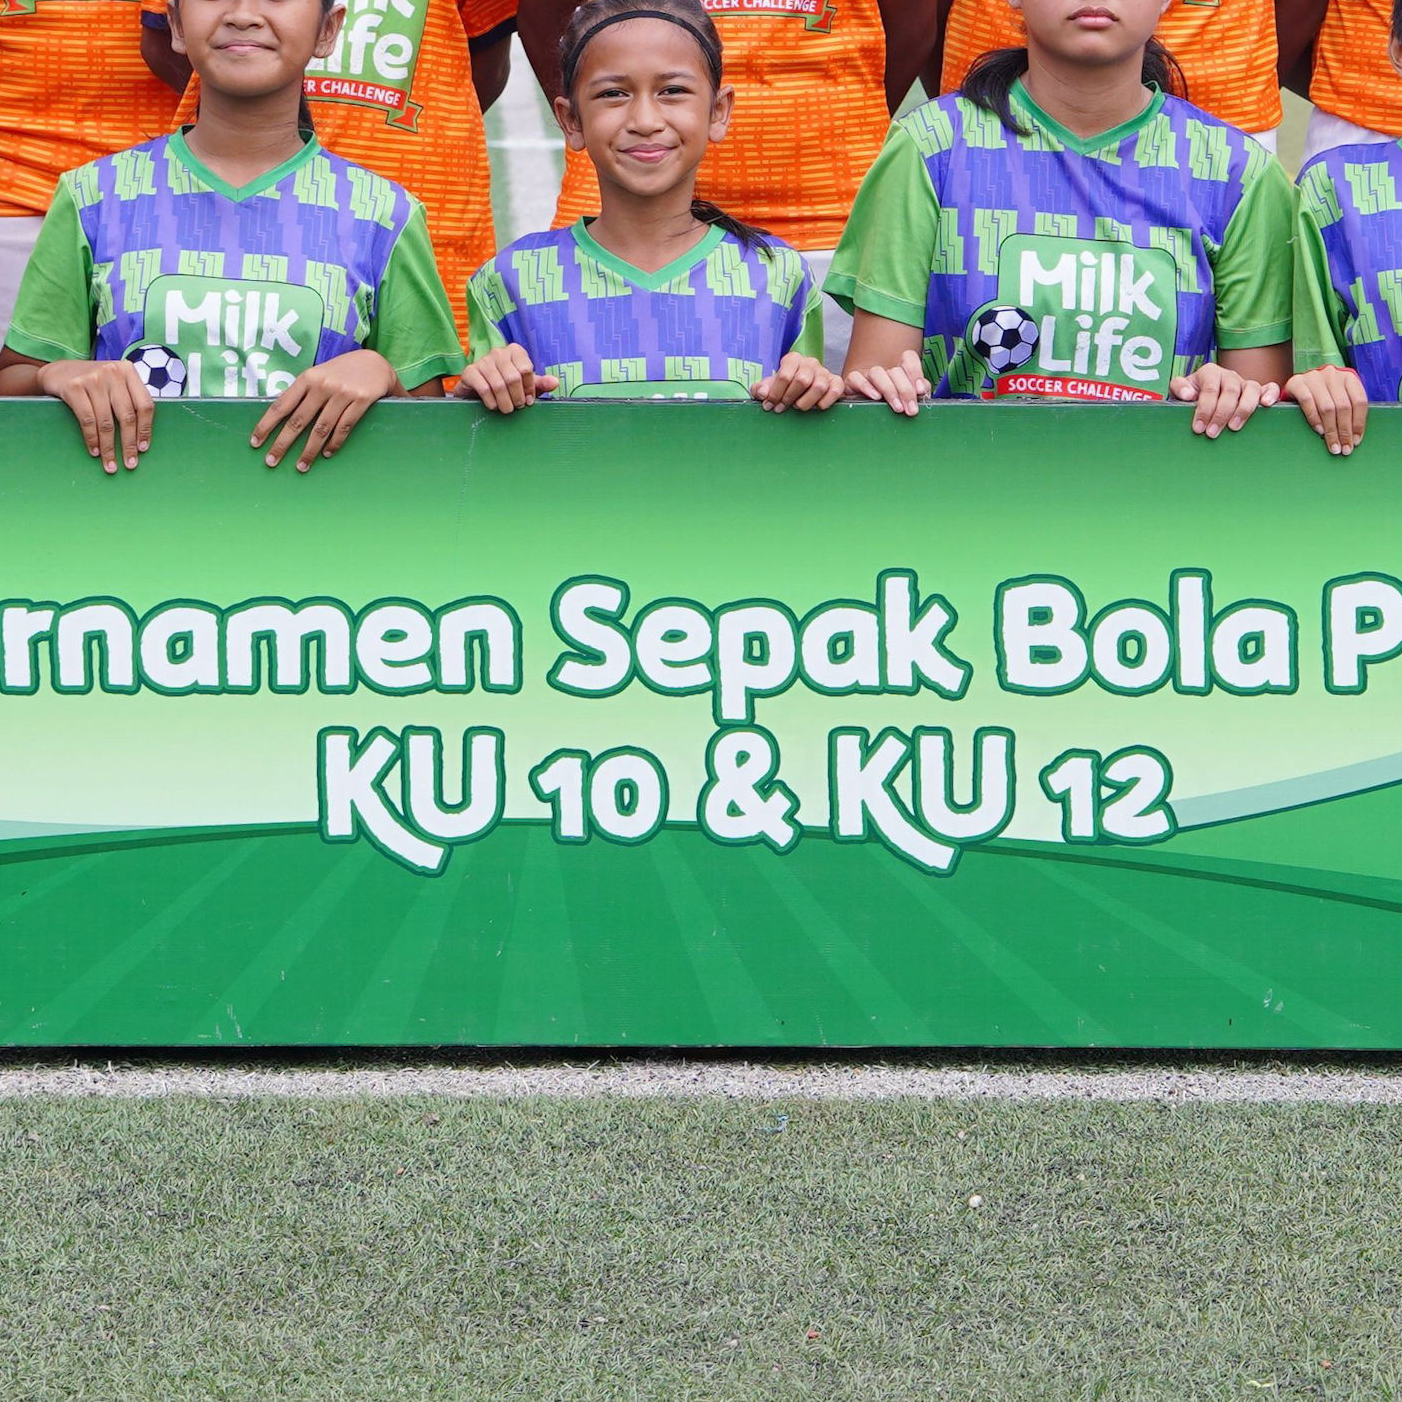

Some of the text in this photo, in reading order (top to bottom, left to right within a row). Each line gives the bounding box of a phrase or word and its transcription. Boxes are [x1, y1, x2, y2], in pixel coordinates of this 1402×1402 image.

[304, 14, 413, 80] ife
[320, 80, 401, 106] CHALLENGE
[1019, 250, 1163, 321] Milk
[165, 289, 302, 357] Milk
[1038, 314, 1163, 382] Life
[1008, 377, 1063, 394] SOCCER
[549, 572, 969, 723] Sepak
[1000, 571, 1298, 695] Bola
[321, 728, 1175, 874] KU 10 & KU 12
